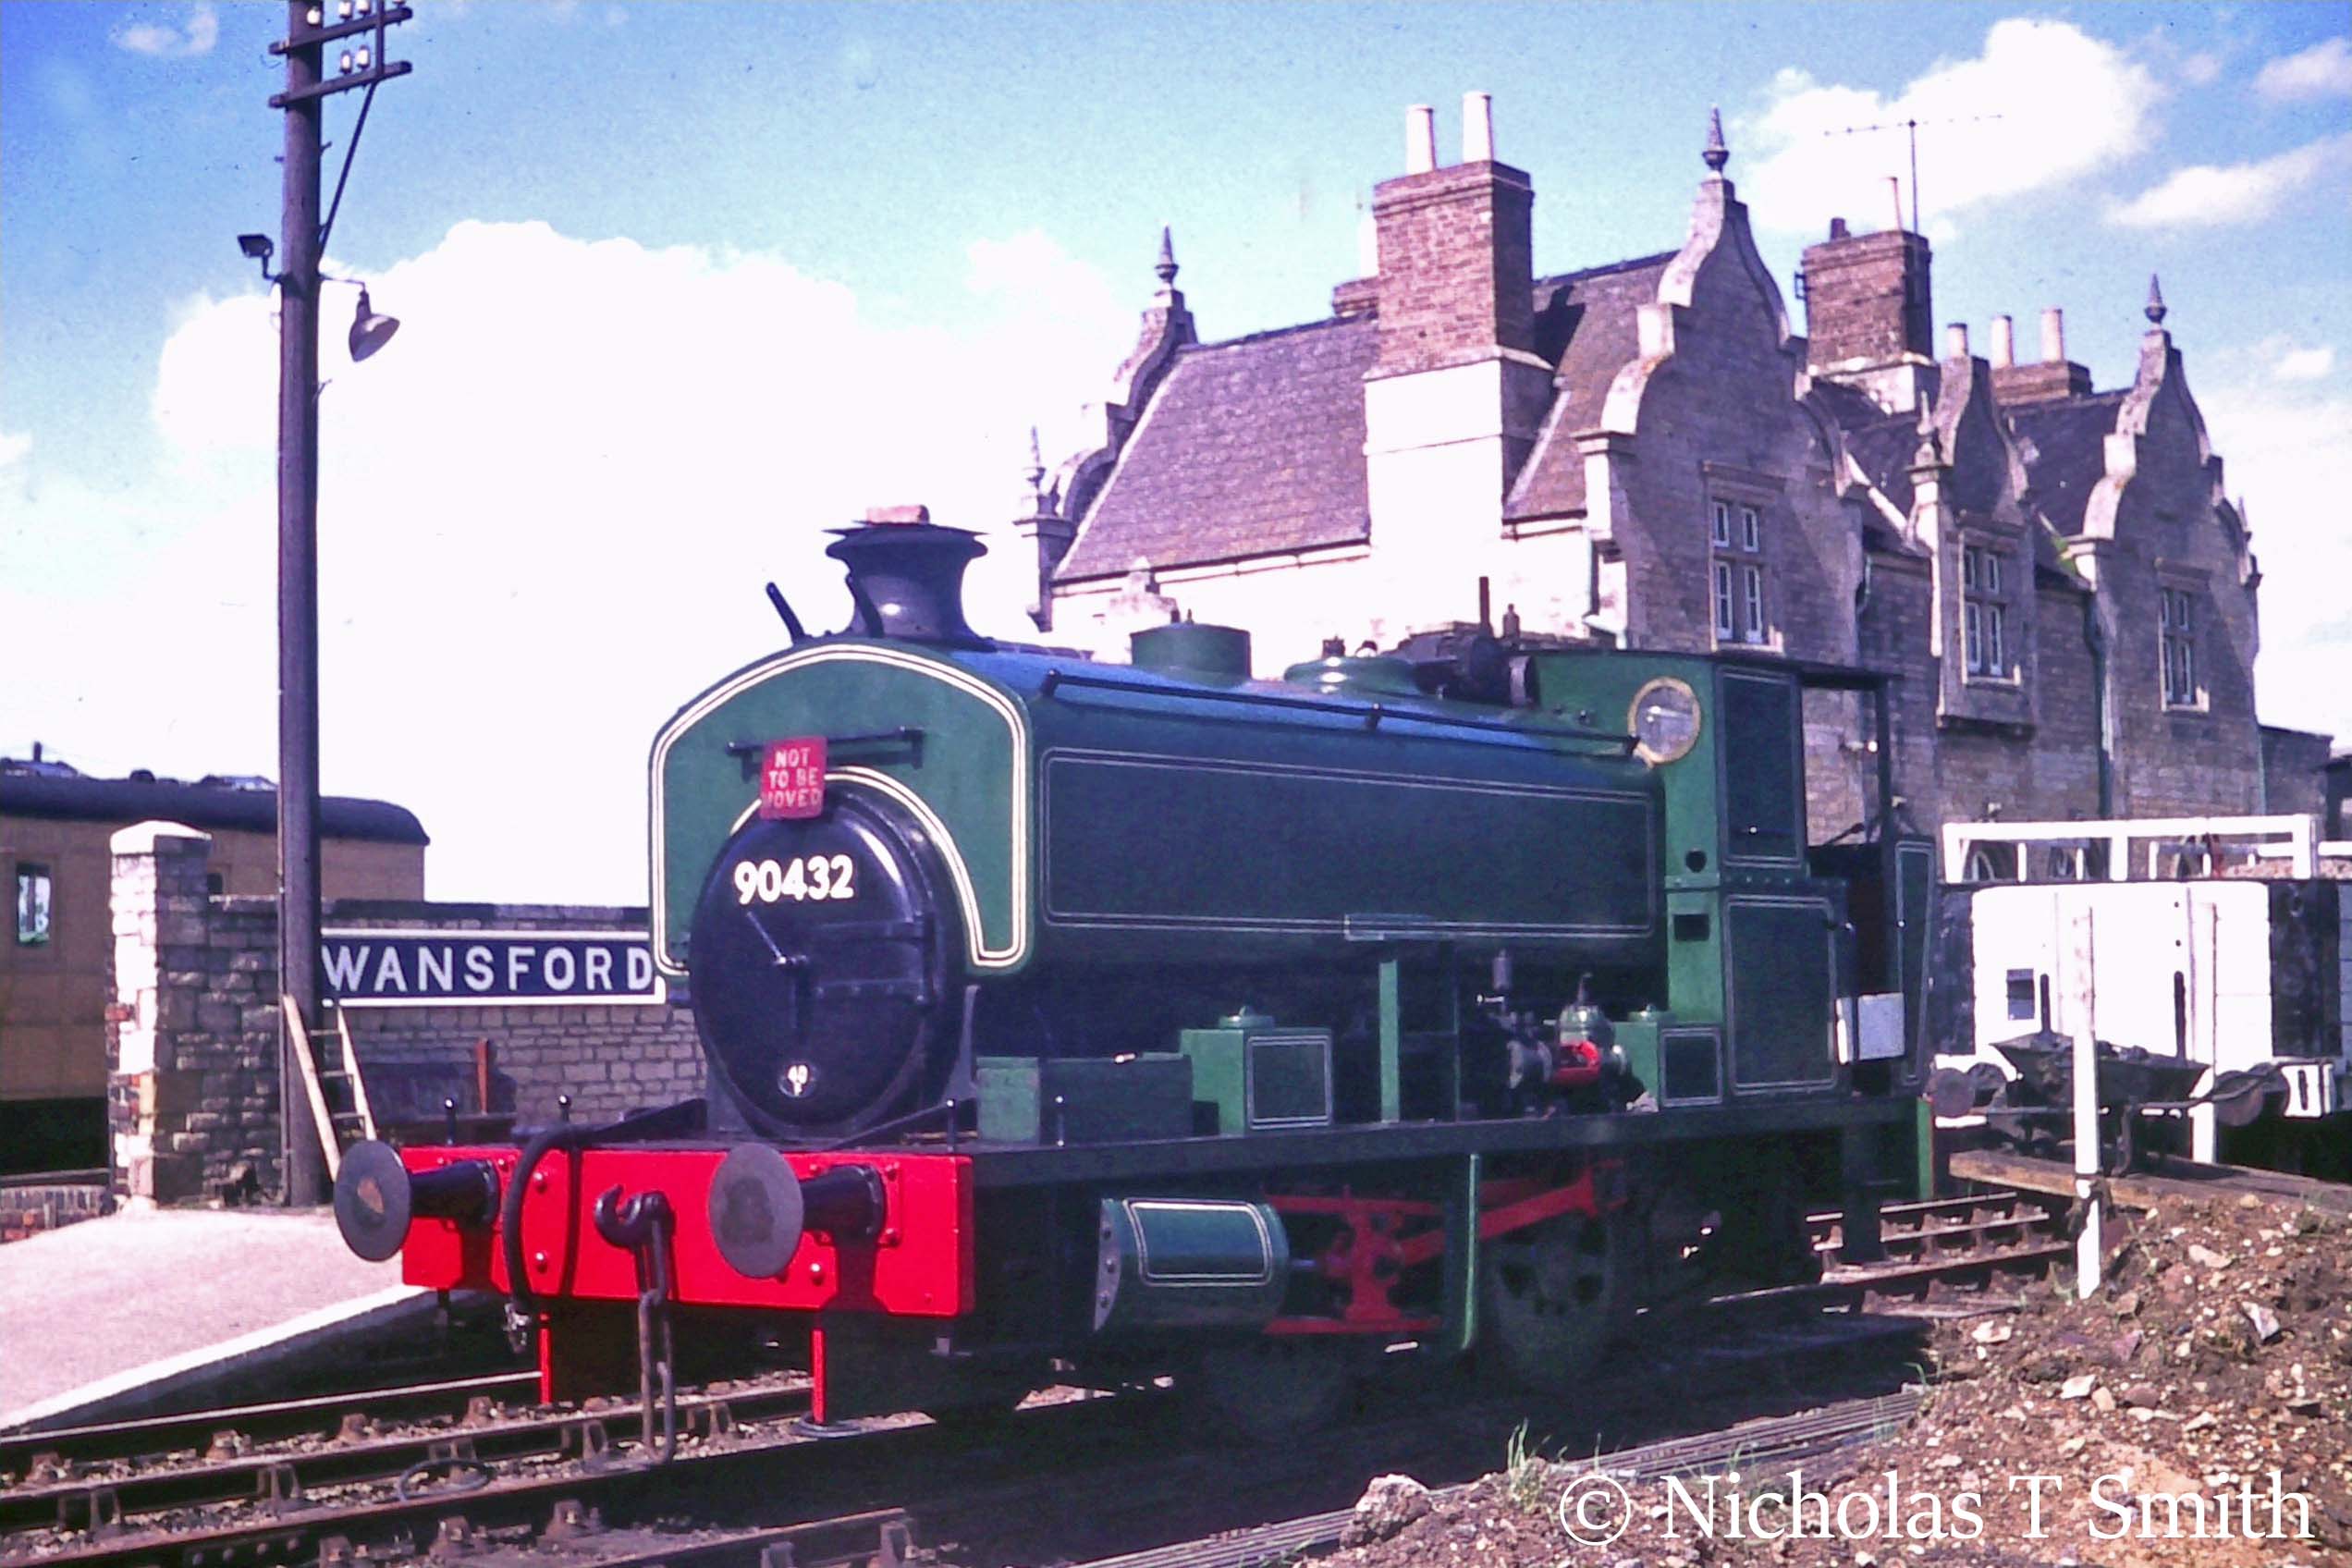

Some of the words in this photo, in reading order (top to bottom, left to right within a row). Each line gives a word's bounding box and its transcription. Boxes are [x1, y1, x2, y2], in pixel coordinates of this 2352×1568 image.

[775, 748, 811, 767] NOT
[767, 769, 790, 790] TO
[796, 766, 819, 787] BE
[734, 854, 854, 905] 90432
[321, 945, 653, 992] WANSFORD
